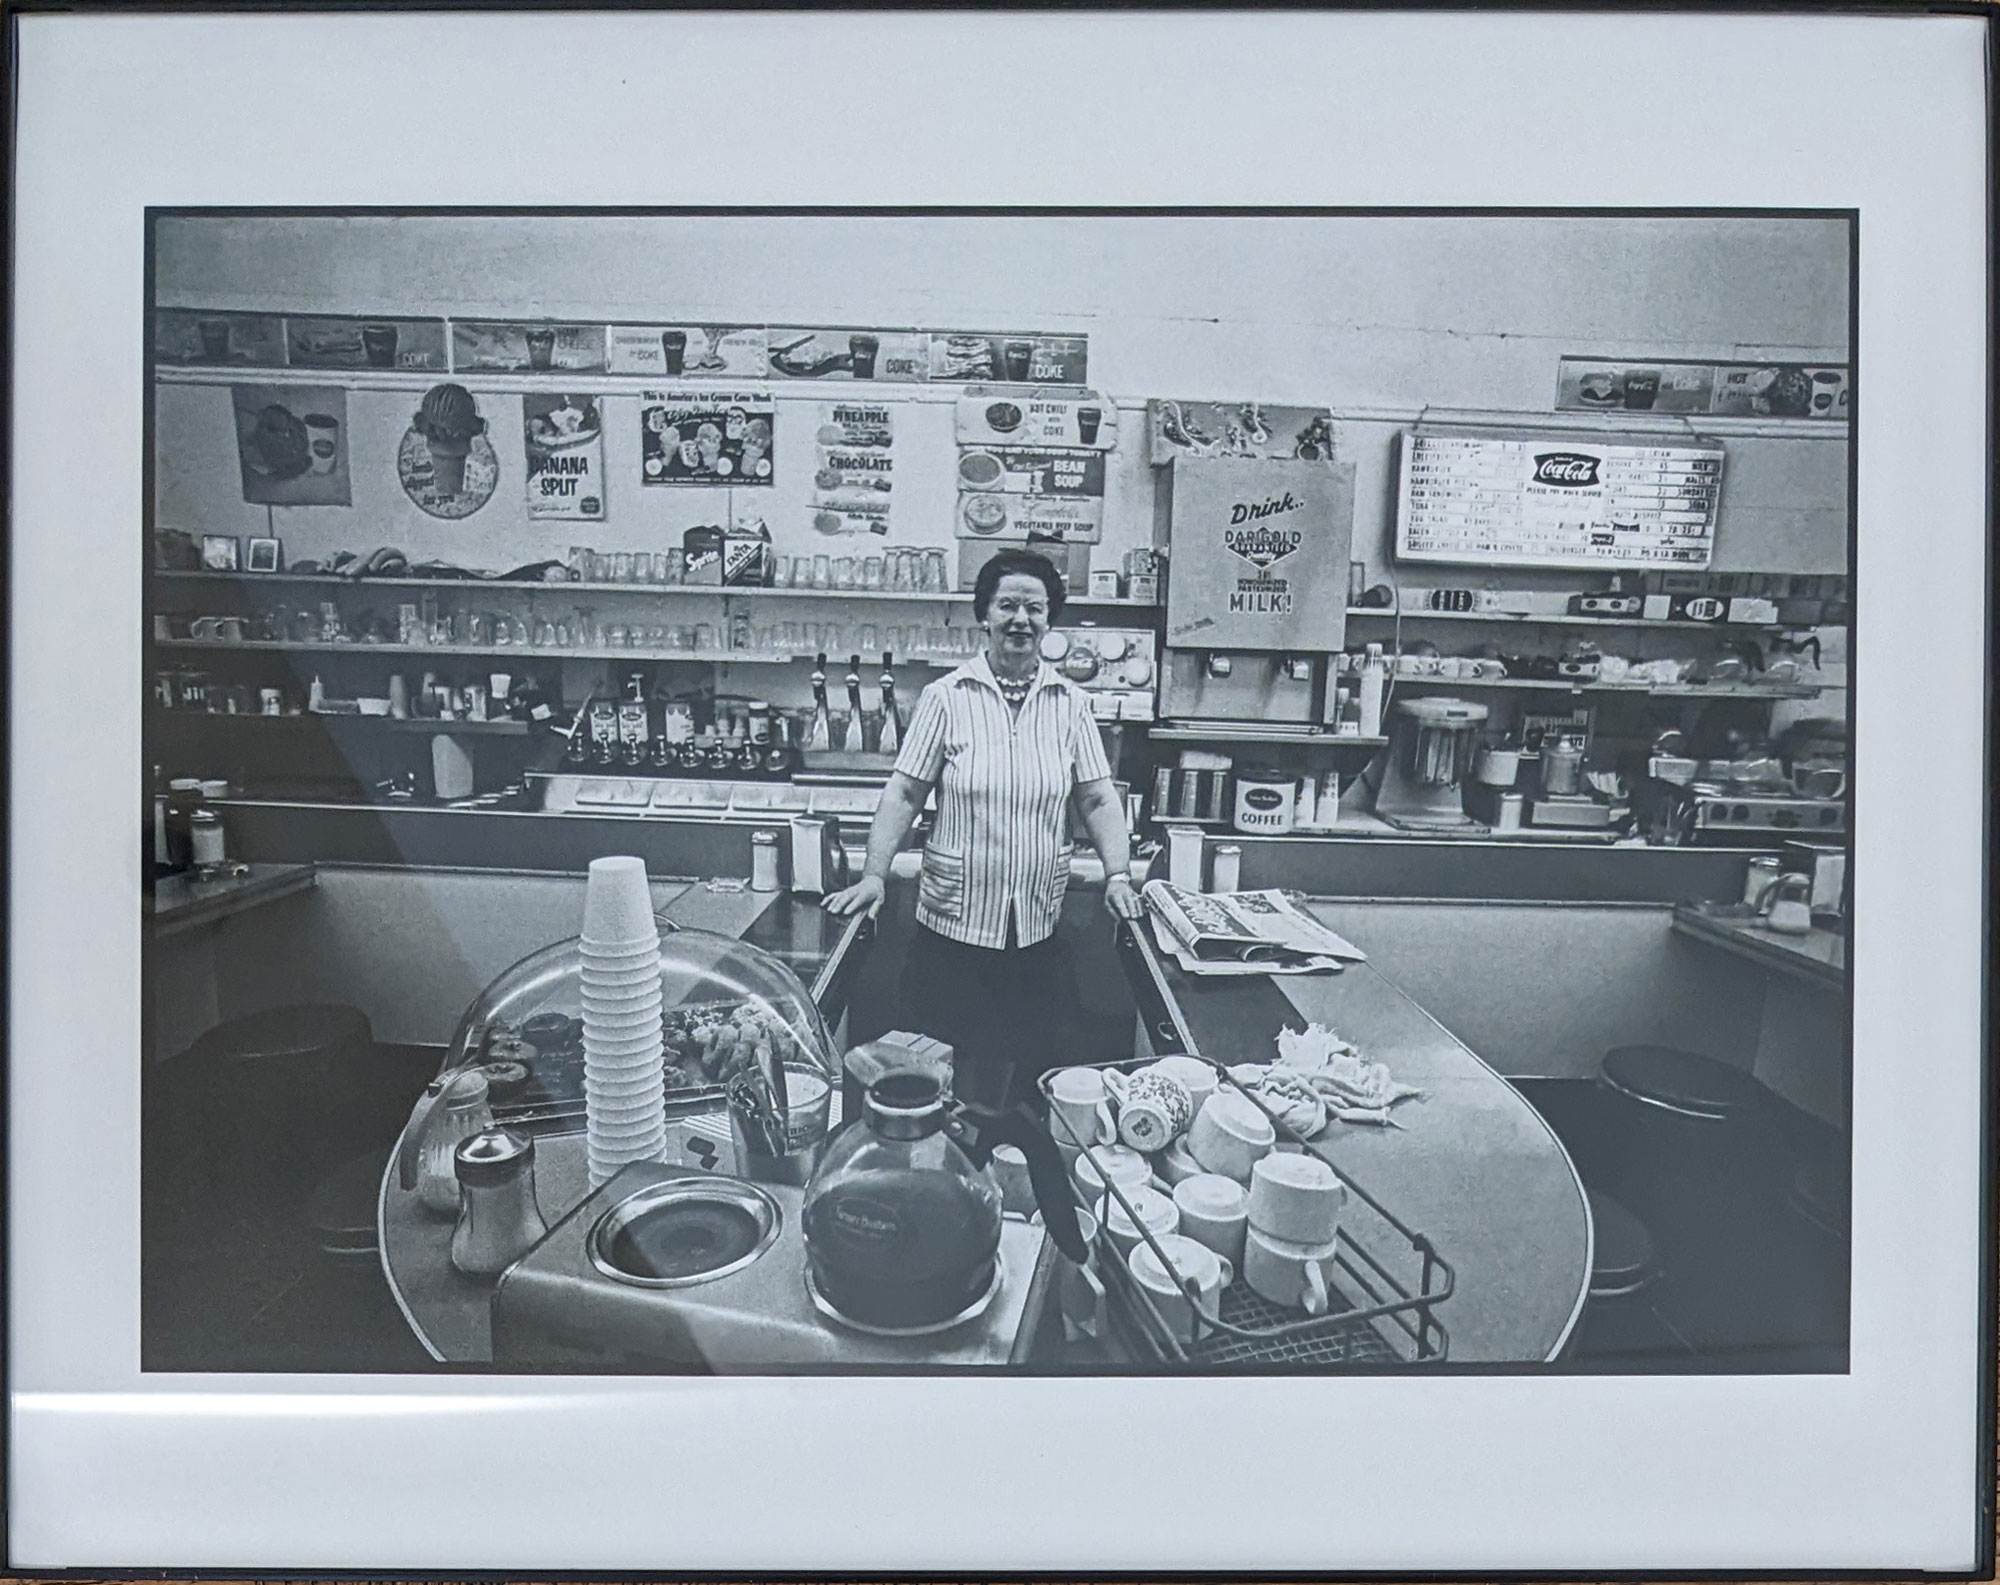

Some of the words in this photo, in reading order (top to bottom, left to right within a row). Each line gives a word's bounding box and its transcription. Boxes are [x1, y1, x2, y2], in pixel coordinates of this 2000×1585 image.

[887, 358, 914, 374] COKE
[1035, 364, 1065, 379] COKE
[1029, 404, 1045, 414] HOT
[832, 410, 889, 423] PINEAPPLE
[1043, 426, 1064, 436] COKE
[828, 456, 893, 471] CHOCOLATE
[1053, 460, 1086, 473] BEAN
[540, 477, 579, 497] SPLIT
[1054, 474, 1084, 488] SOUP
[1224, 530, 1302, 544] DARIGOLD
[685, 550, 719, 572] Sprite
[726, 543, 752, 567] FANTA
[1229, 593, 1292, 613] MILK!
[1241, 812, 1283, 826] COFFEE
